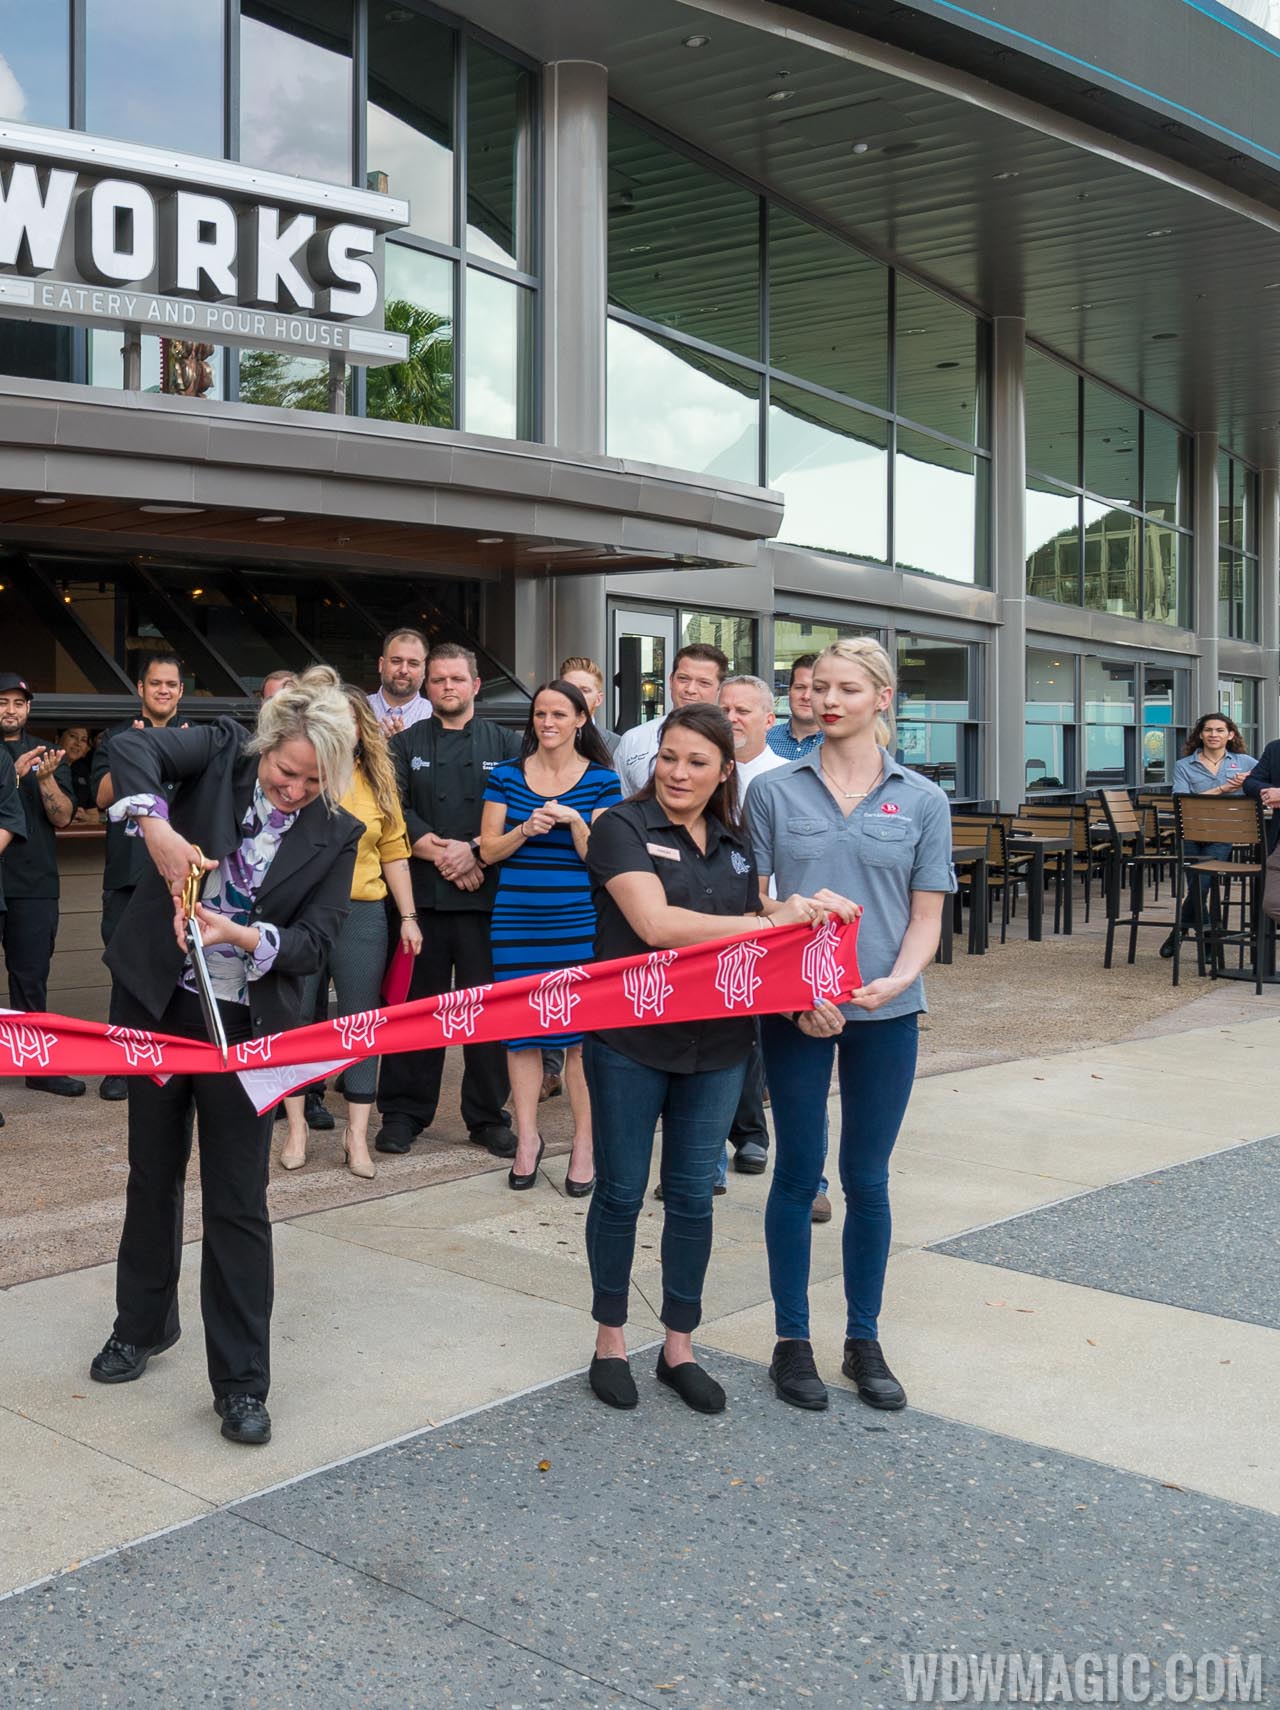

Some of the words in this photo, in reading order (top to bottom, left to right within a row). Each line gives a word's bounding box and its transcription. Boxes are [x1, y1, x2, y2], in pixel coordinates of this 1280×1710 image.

[42, 285, 145, 317] EATERY
[147, 297, 195, 326] AND
[207, 308, 266, 337] POUR
[275, 318, 344, 347] HOUSE
